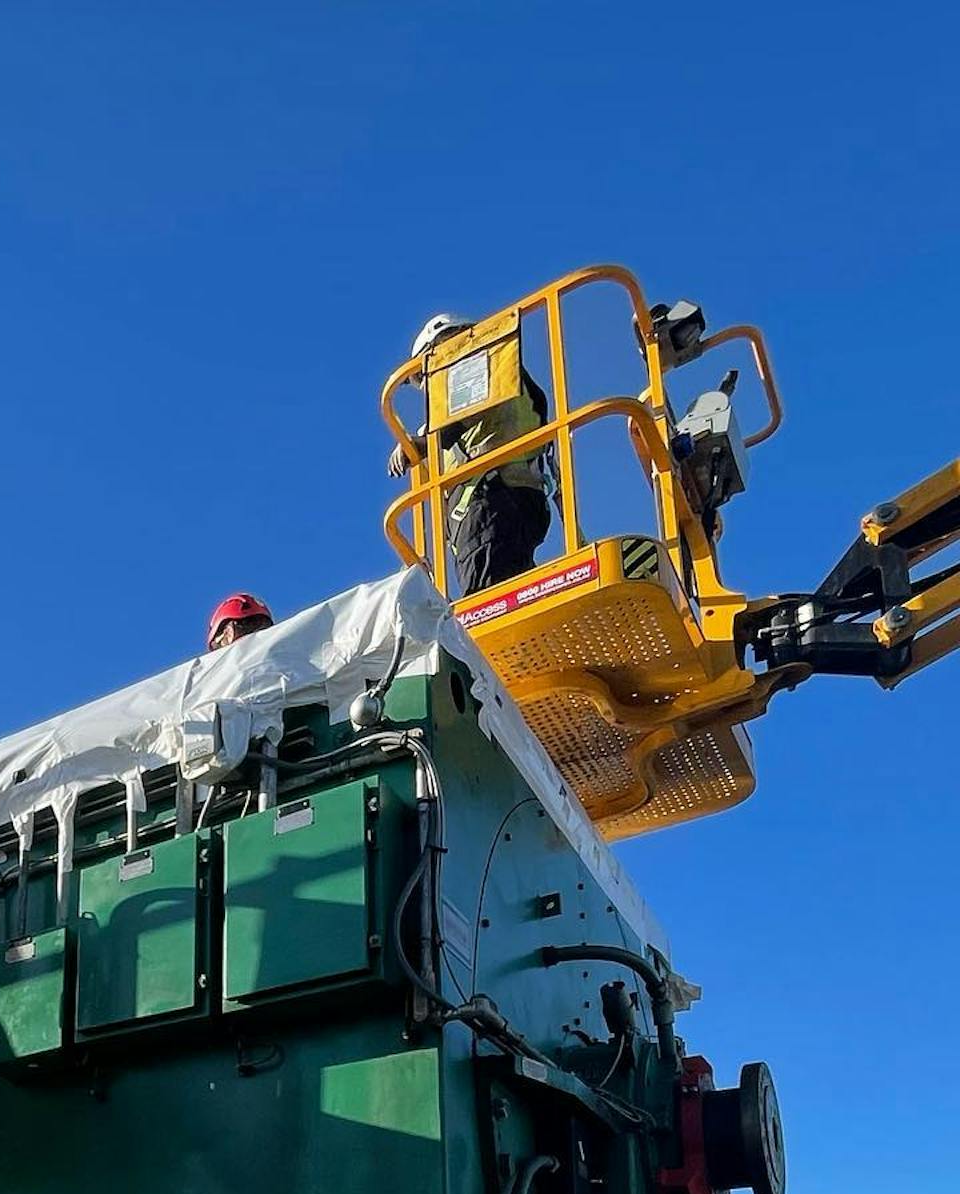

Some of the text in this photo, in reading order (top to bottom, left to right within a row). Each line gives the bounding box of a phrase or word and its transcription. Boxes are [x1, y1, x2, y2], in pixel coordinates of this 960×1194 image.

[516, 584, 539, 601] 0800
[539, 574, 565, 591] HIRE
[564, 564, 592, 582] NOW
